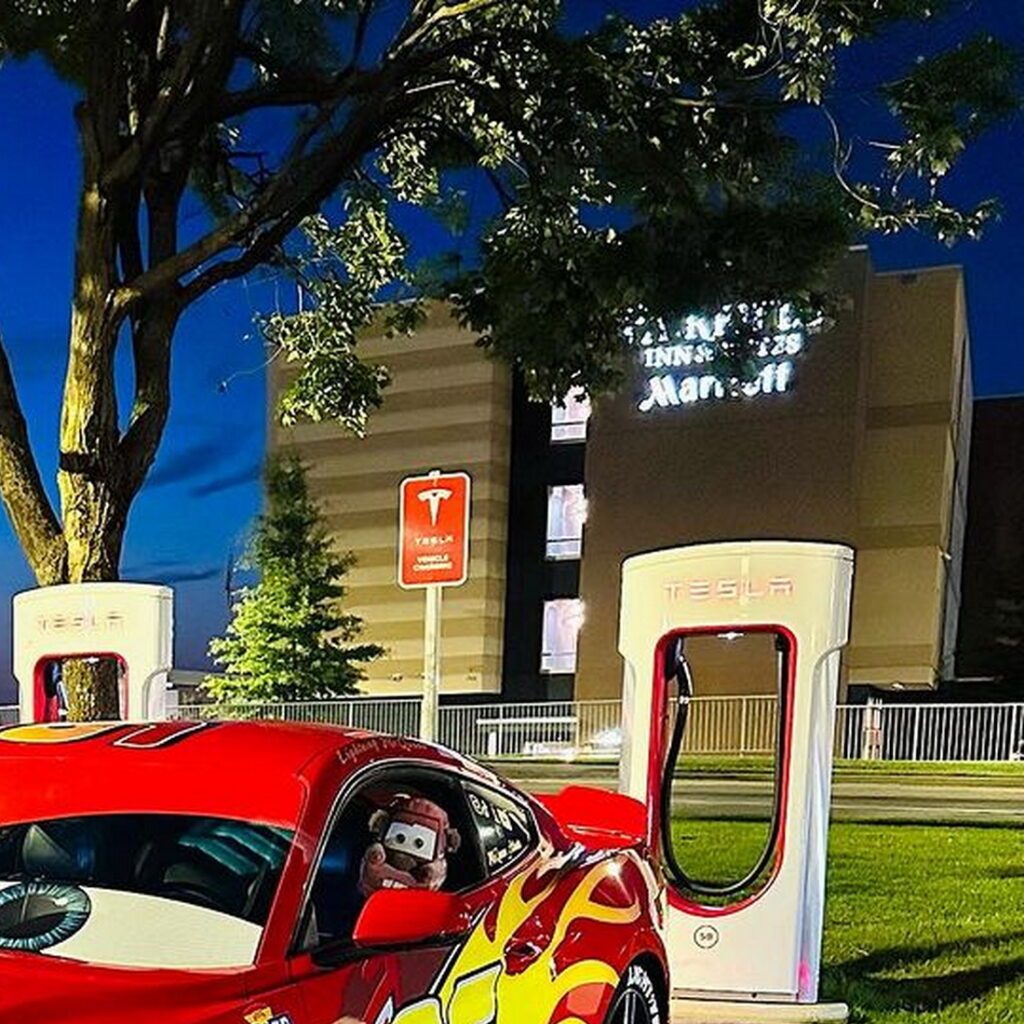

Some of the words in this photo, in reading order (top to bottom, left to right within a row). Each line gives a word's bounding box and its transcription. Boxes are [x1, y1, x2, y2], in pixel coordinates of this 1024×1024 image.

[644, 344, 694, 367] INN
[414, 535, 454, 546] TESLA
[662, 576, 795, 601] TESLA
[36, 610, 125, 633] TESLA
